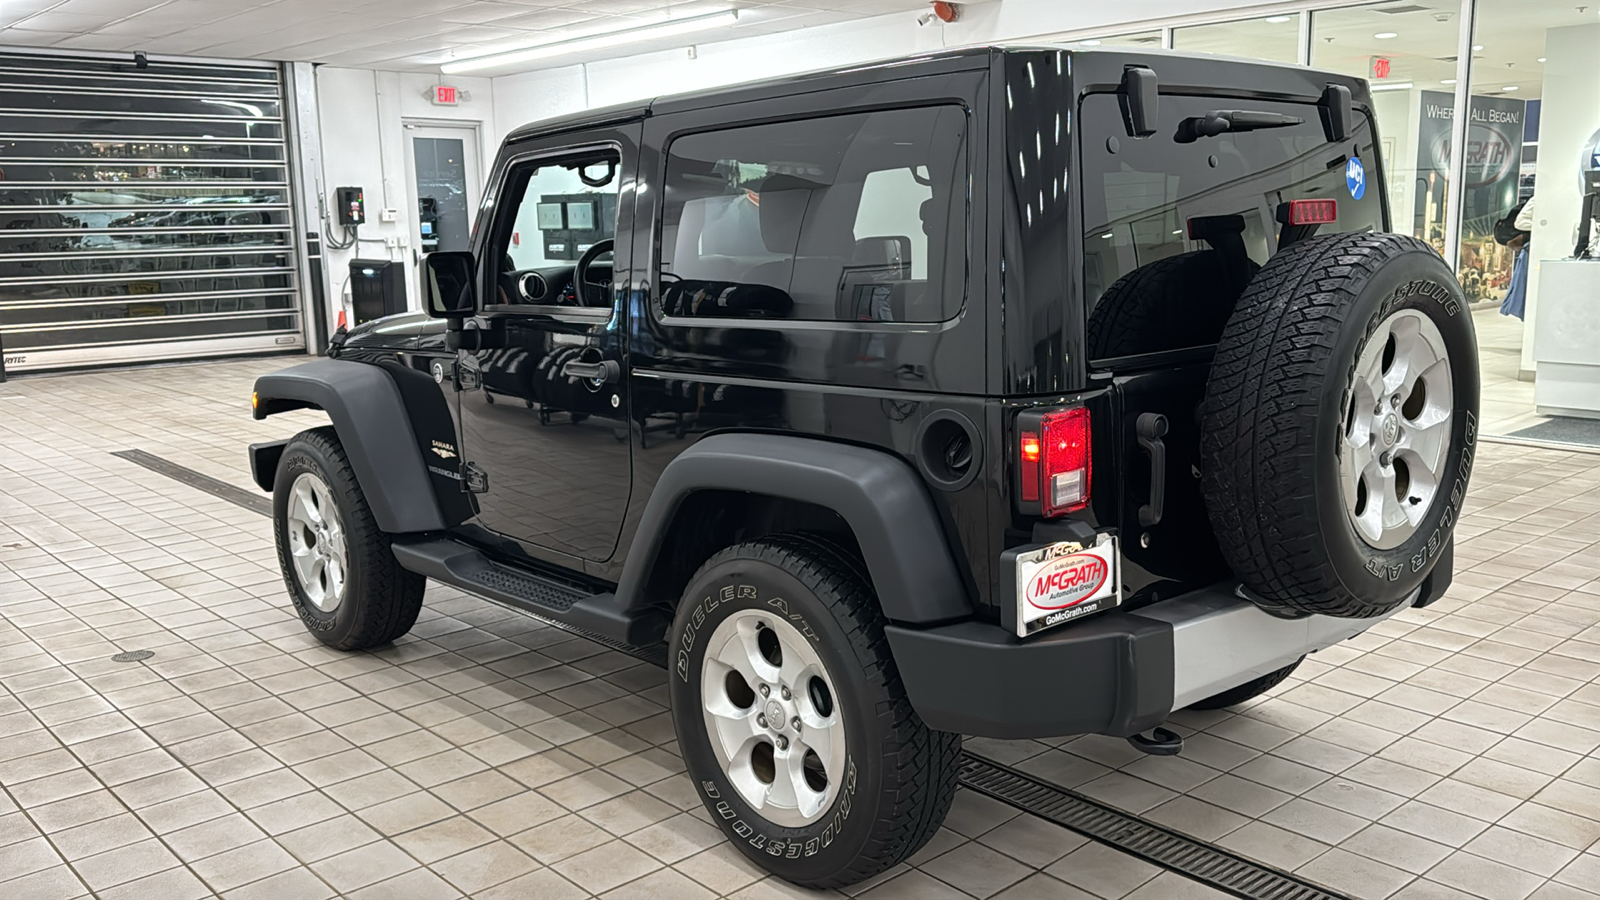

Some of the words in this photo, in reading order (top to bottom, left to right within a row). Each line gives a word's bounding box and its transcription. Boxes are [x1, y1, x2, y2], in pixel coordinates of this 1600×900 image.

[1376, 59, 1389, 78] EXIT
[437, 86, 456, 103] EXIT
[1427, 105, 1454, 119] WHER
[1471, 108, 1487, 122] ALL
[1489, 109, 1519, 123] BEGAN!
[5, 356, 26, 364] RYTEC
[432, 440, 454, 451] SAHARA
[428, 465, 461, 480] WRANGLE
[1410, 410, 1477, 573] DUELER
[1054, 559, 1085, 571] GoMcGrath.com
[1366, 559, 1403, 582] A/T
[1034, 562, 1102, 597] McGRATH
[1048, 587, 1078, 600] Automotive
[1079, 582, 1095, 593] Group
[1046, 603, 1097, 625] GoMcGrath.com
[677, 584, 757, 683] DUELER
[767, 597, 820, 642] A/T
[702, 754, 858, 859] BRIDGESTONE
